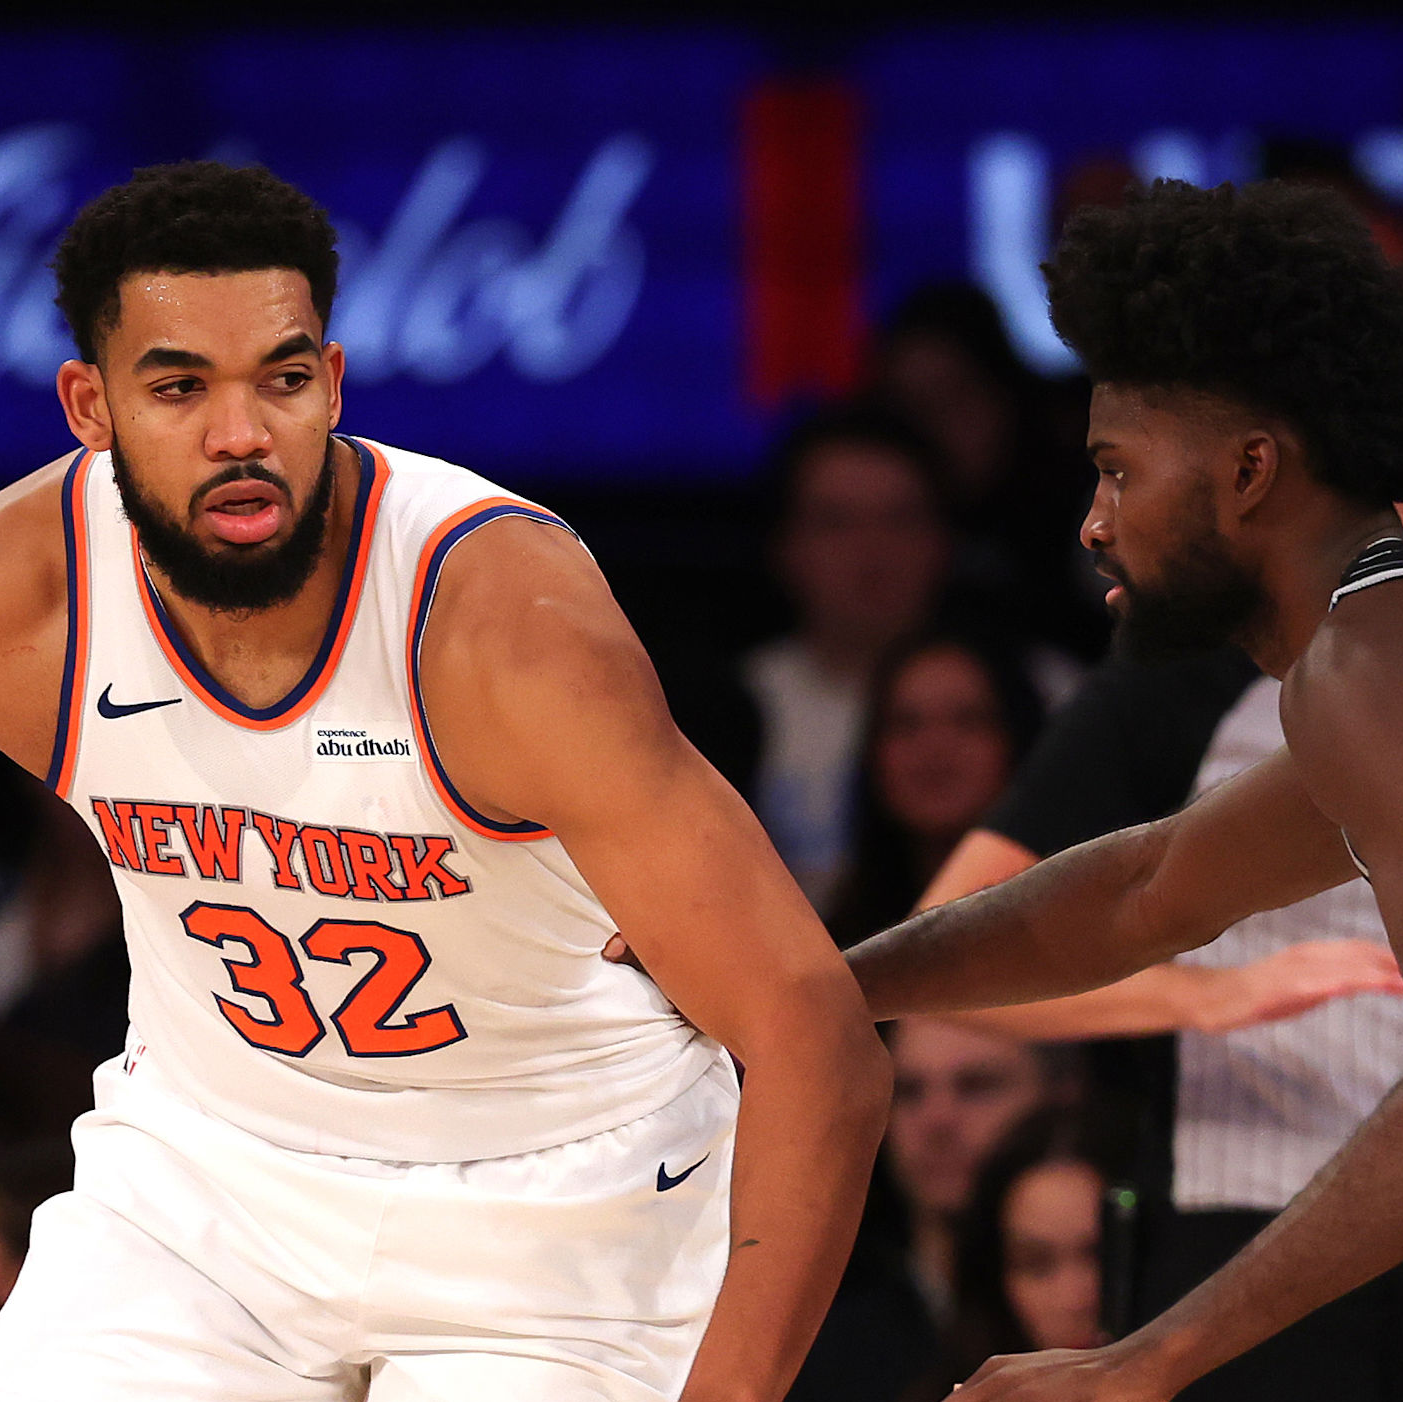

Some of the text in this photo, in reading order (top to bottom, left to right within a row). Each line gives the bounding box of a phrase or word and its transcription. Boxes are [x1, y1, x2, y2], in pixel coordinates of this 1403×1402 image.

[316, 738, 411, 756] abu dhabi
[317, 729, 367, 738] experience
[90, 797, 474, 903] NEW YORK
[178, 900, 468, 1058] 32
